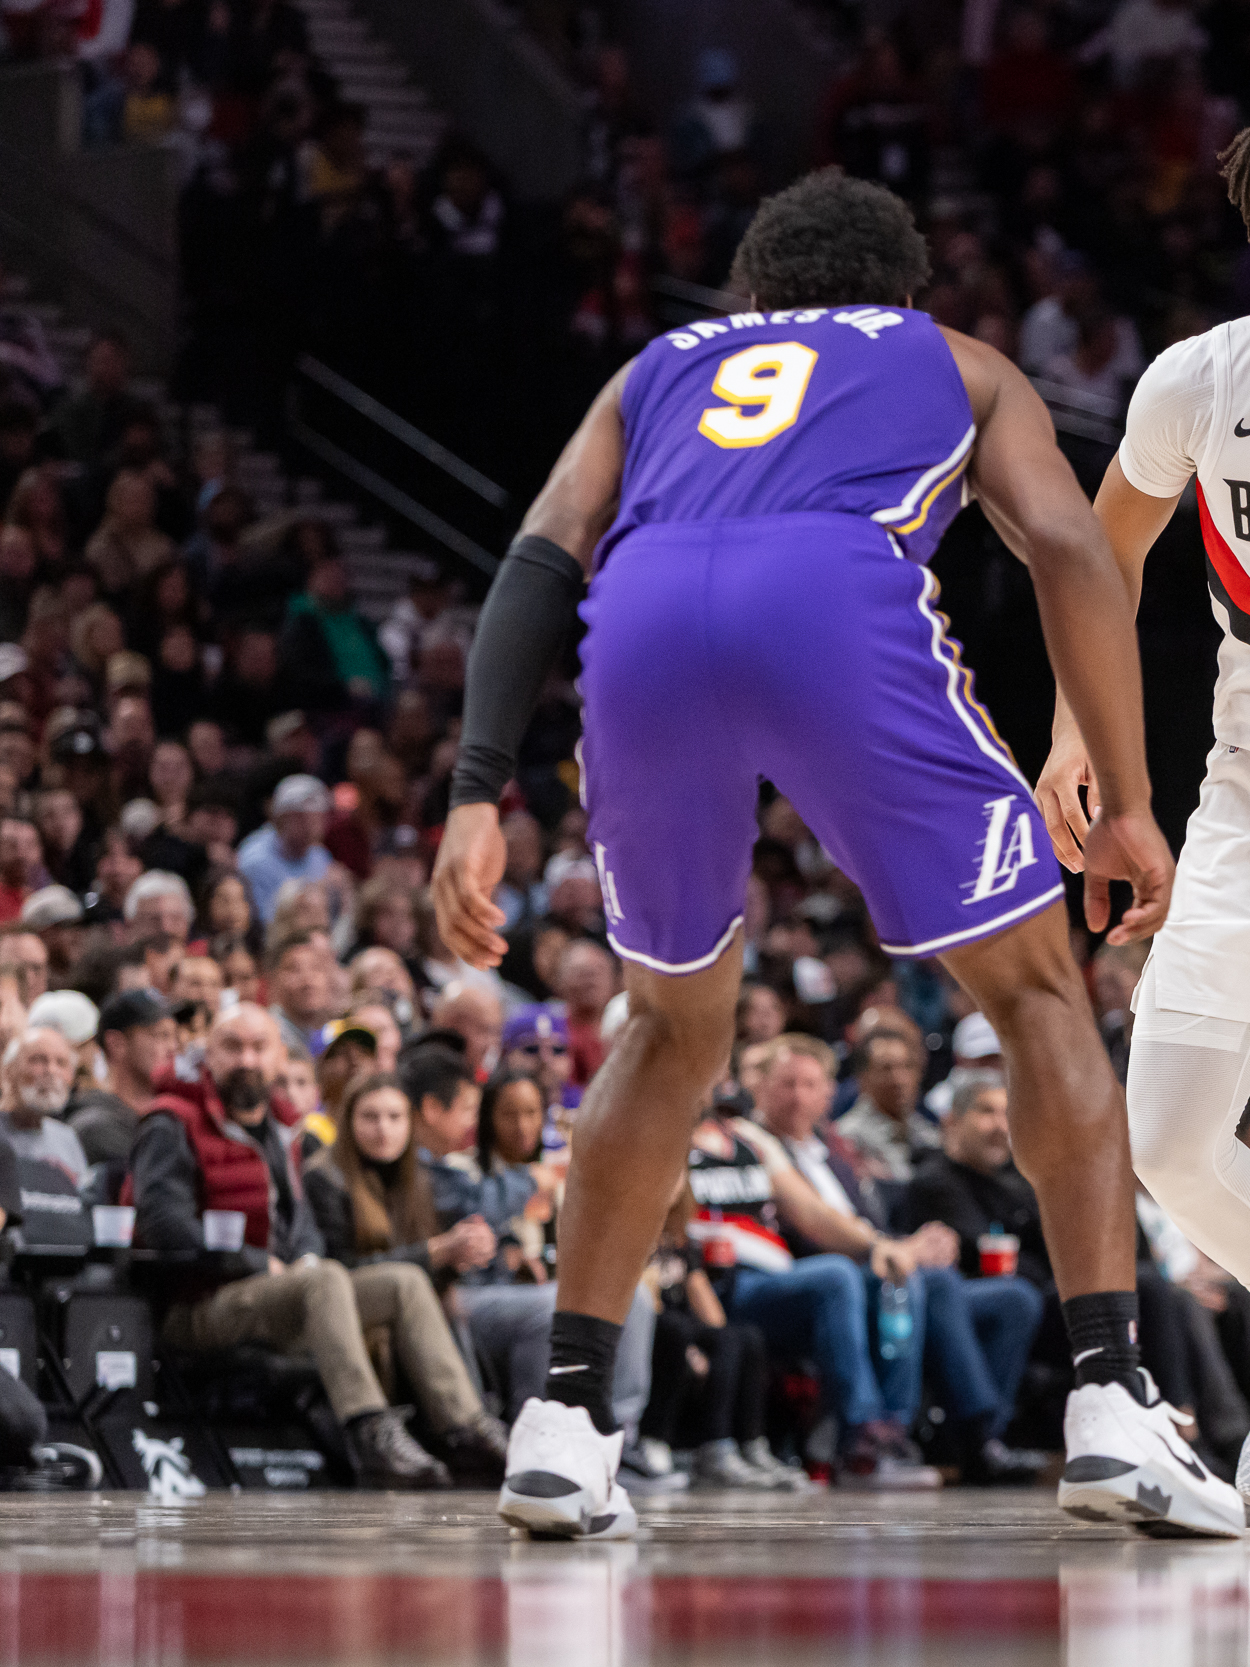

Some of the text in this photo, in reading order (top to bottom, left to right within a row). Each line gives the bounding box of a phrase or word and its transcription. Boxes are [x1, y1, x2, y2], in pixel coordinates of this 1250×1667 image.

[665, 307, 904, 350] JAMES JR.
[698, 342, 818, 449] 9
